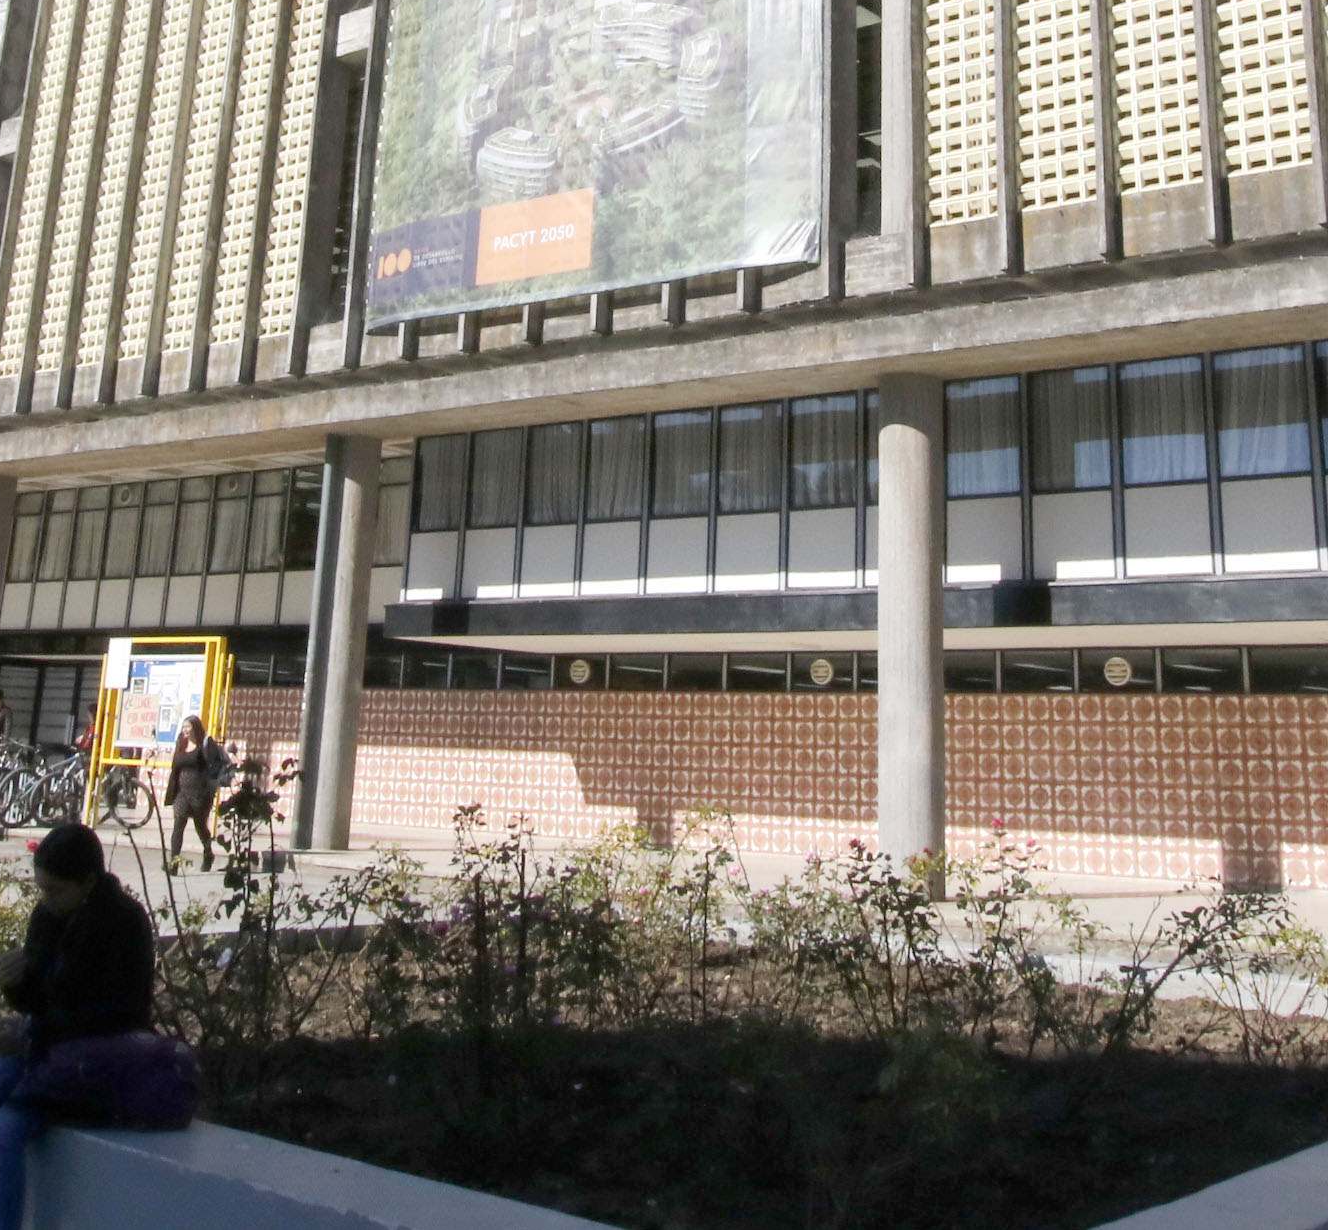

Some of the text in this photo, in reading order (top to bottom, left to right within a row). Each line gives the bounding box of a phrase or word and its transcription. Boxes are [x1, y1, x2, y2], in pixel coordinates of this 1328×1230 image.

[493, 223, 575, 251] PACYT 2050
[376, 248, 412, 281] 100
